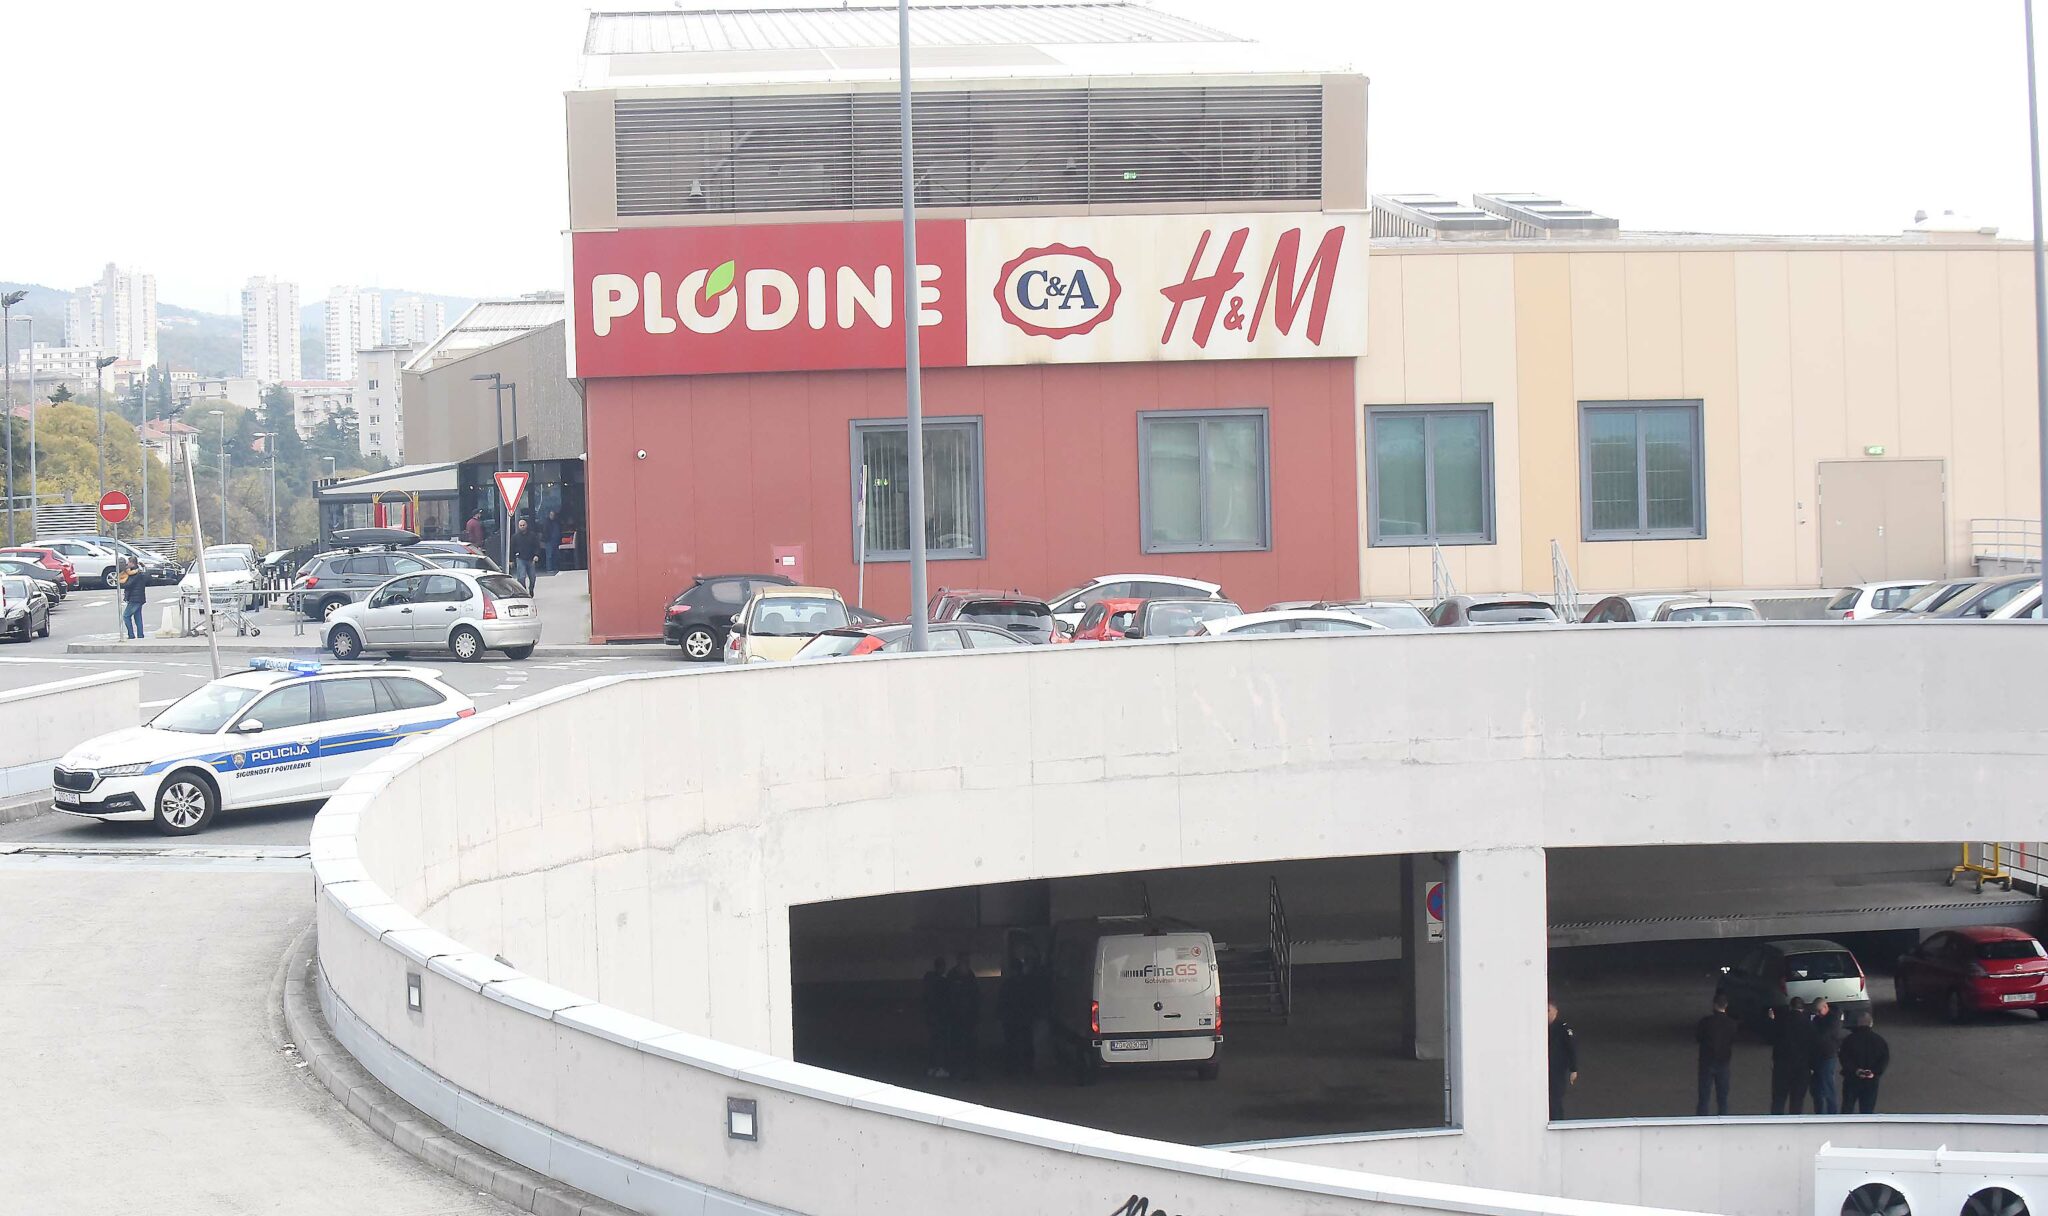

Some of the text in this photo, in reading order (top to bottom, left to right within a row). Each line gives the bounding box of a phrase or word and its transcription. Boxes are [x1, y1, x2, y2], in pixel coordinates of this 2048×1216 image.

[592, 264, 943, 337] PLODINE
[1016, 269, 1099, 311] C&A
[1160, 225, 1346, 349] H&M
[236, 768, 271, 778] SIGURNOST
[275, 762, 311, 772] POVJERENJE
[251, 745, 309, 762] POLICIJA
